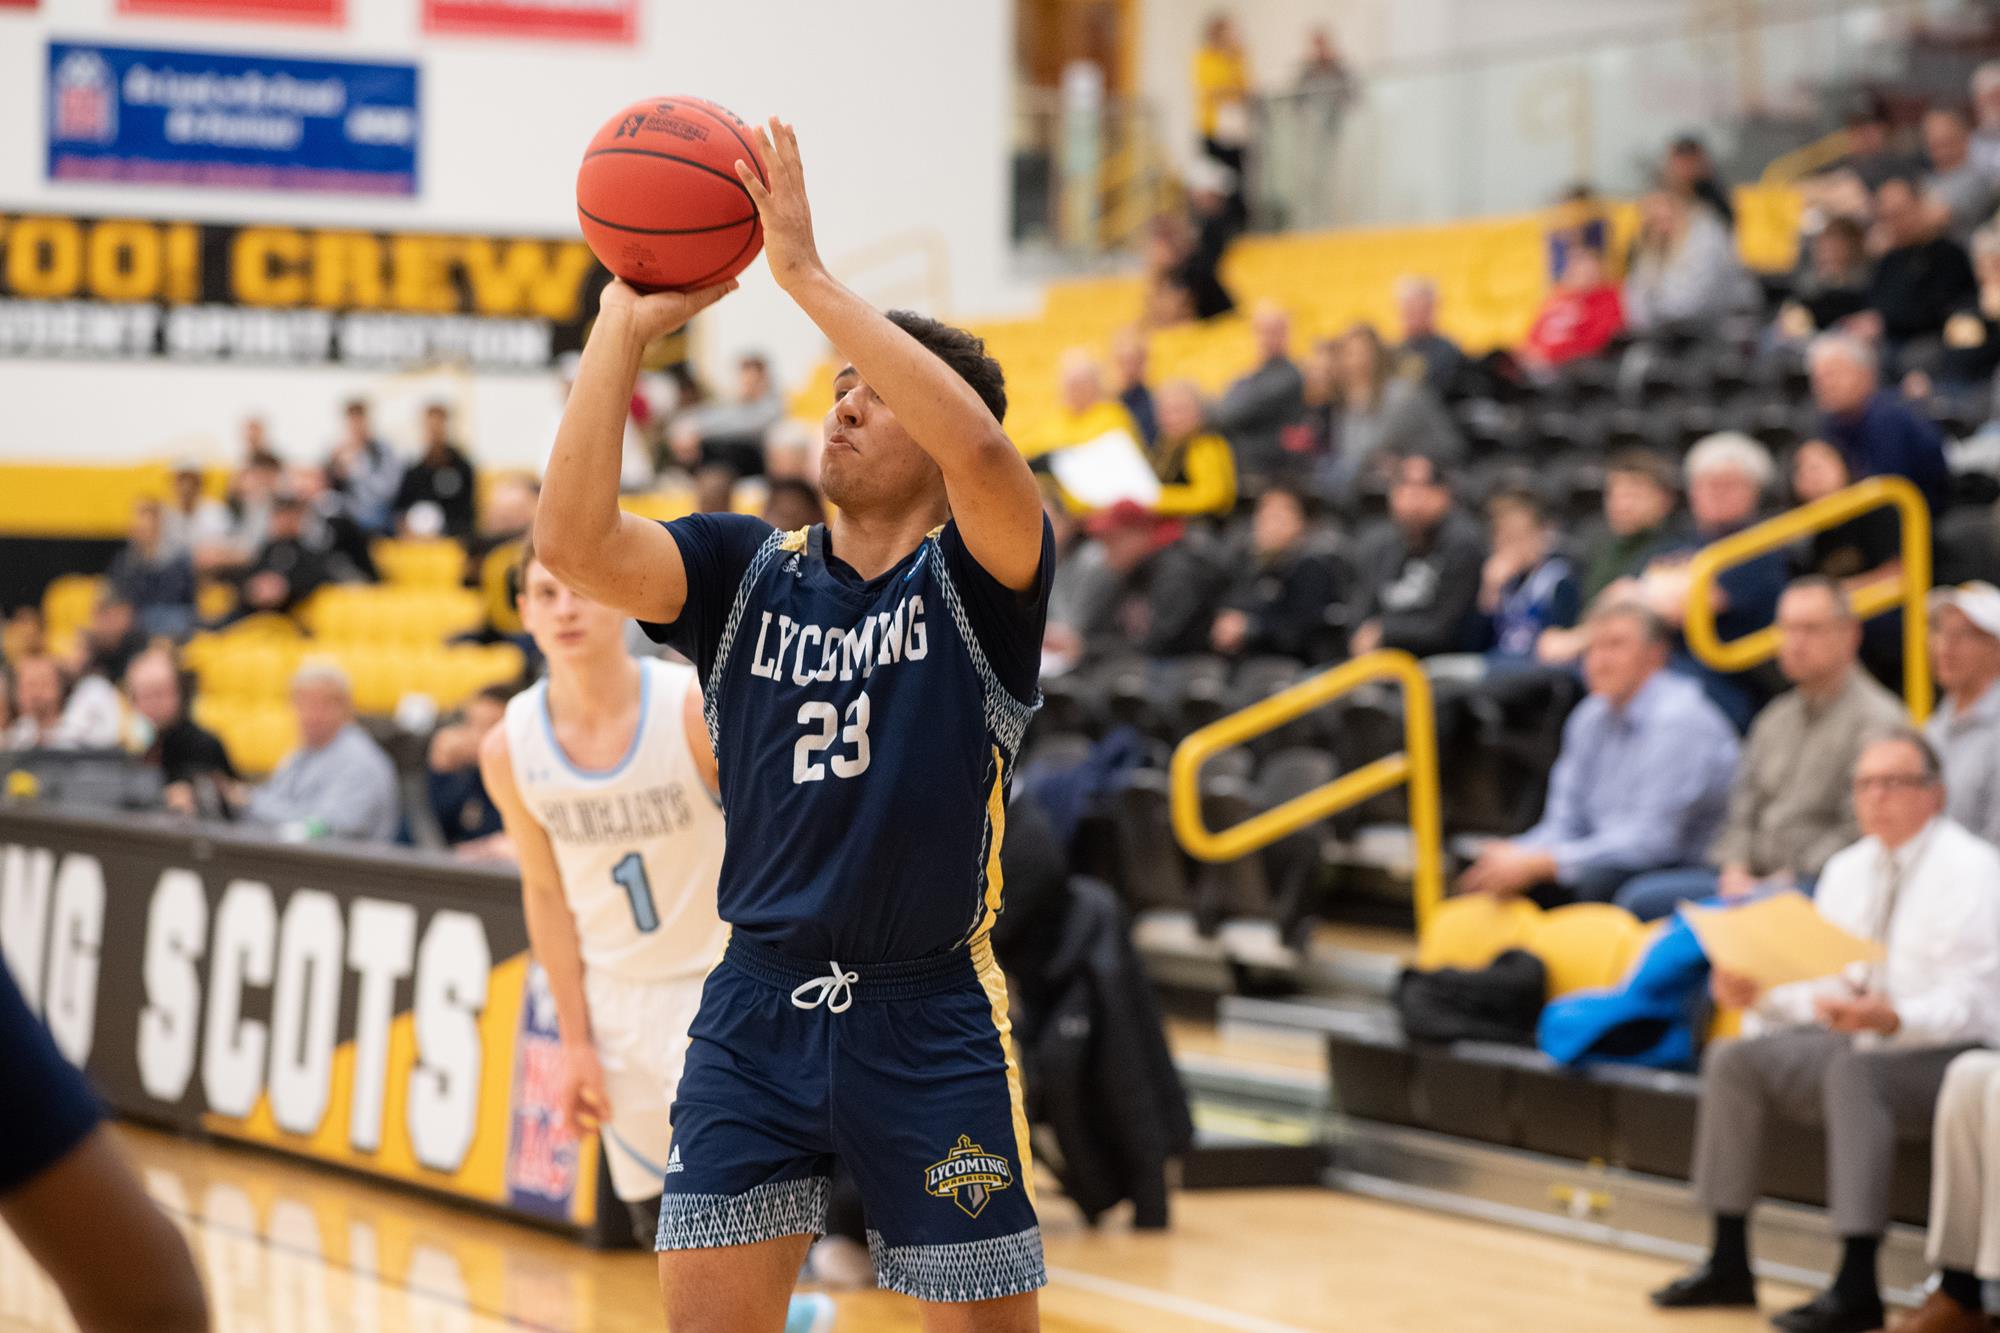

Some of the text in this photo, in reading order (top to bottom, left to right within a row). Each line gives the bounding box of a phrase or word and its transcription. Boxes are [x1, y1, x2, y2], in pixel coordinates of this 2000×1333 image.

[0, 214, 198, 304] OO!
[231, 224, 591, 322] CREW
[750, 594, 928, 687] LYCOMING
[793, 690, 871, 784] 23
[612, 852, 661, 933] 1
[136, 866, 490, 1174] SCOTS
[929, 1157, 1009, 1187] LYCOMING
[941, 1174, 1000, 1190] WARRIORS
